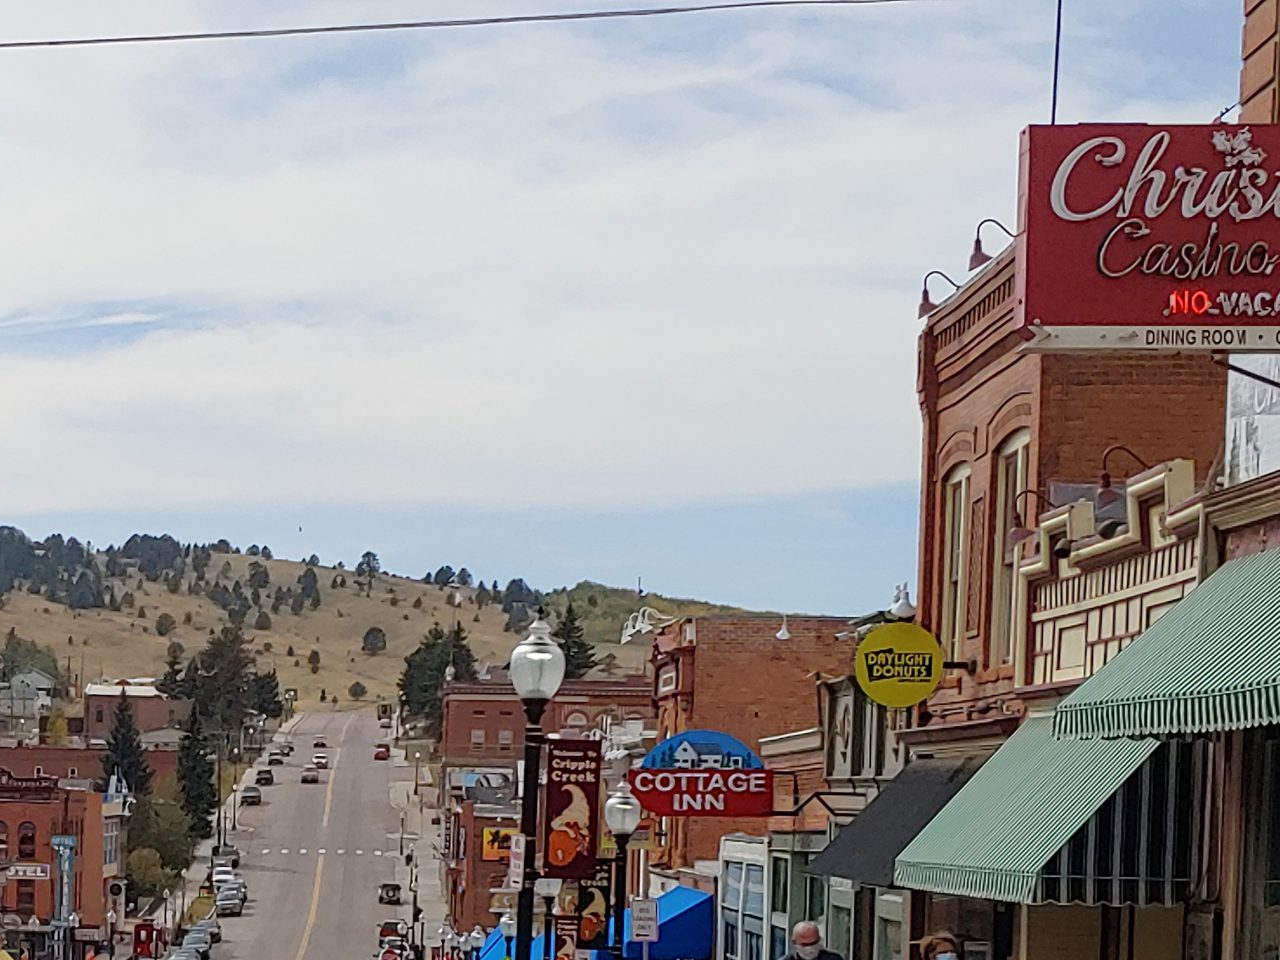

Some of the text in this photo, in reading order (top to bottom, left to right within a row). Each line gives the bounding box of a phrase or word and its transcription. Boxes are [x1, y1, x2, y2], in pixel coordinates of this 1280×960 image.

[1099, 218, 1271, 279] Casino
[1169, 290, 1208, 314] NO
[1145, 329, 1247, 345] DINING ROOM
[867, 652, 932, 667] DAYLIGHT
[872, 665, 927, 677] DONUTS
[552, 758, 597, 771] Cripple
[551, 770, 596, 783] Creek
[634, 772, 767, 792] COTTAGE
[673, 793, 725, 811] INN
[6, 866, 46, 876] OTEL
